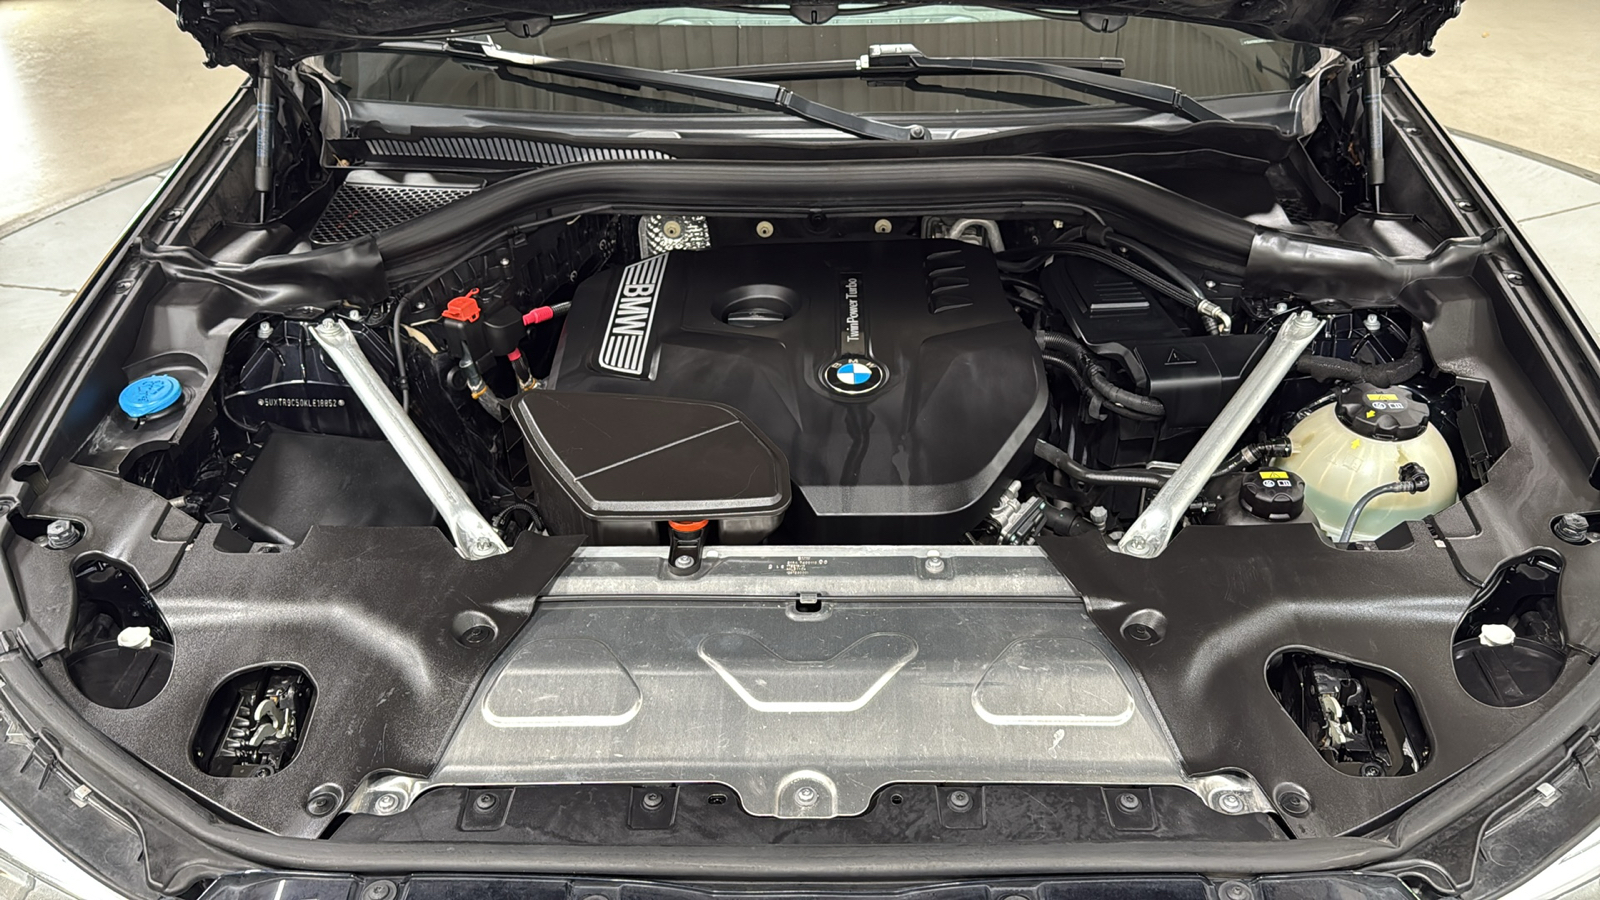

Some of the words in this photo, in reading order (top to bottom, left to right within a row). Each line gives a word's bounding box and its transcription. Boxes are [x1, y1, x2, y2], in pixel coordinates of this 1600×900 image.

[845, 278, 858, 299] Turbo
[612, 283, 656, 336] BMW
[846, 299, 860, 342] TwinPower
[831, 359, 876, 369] BMW
